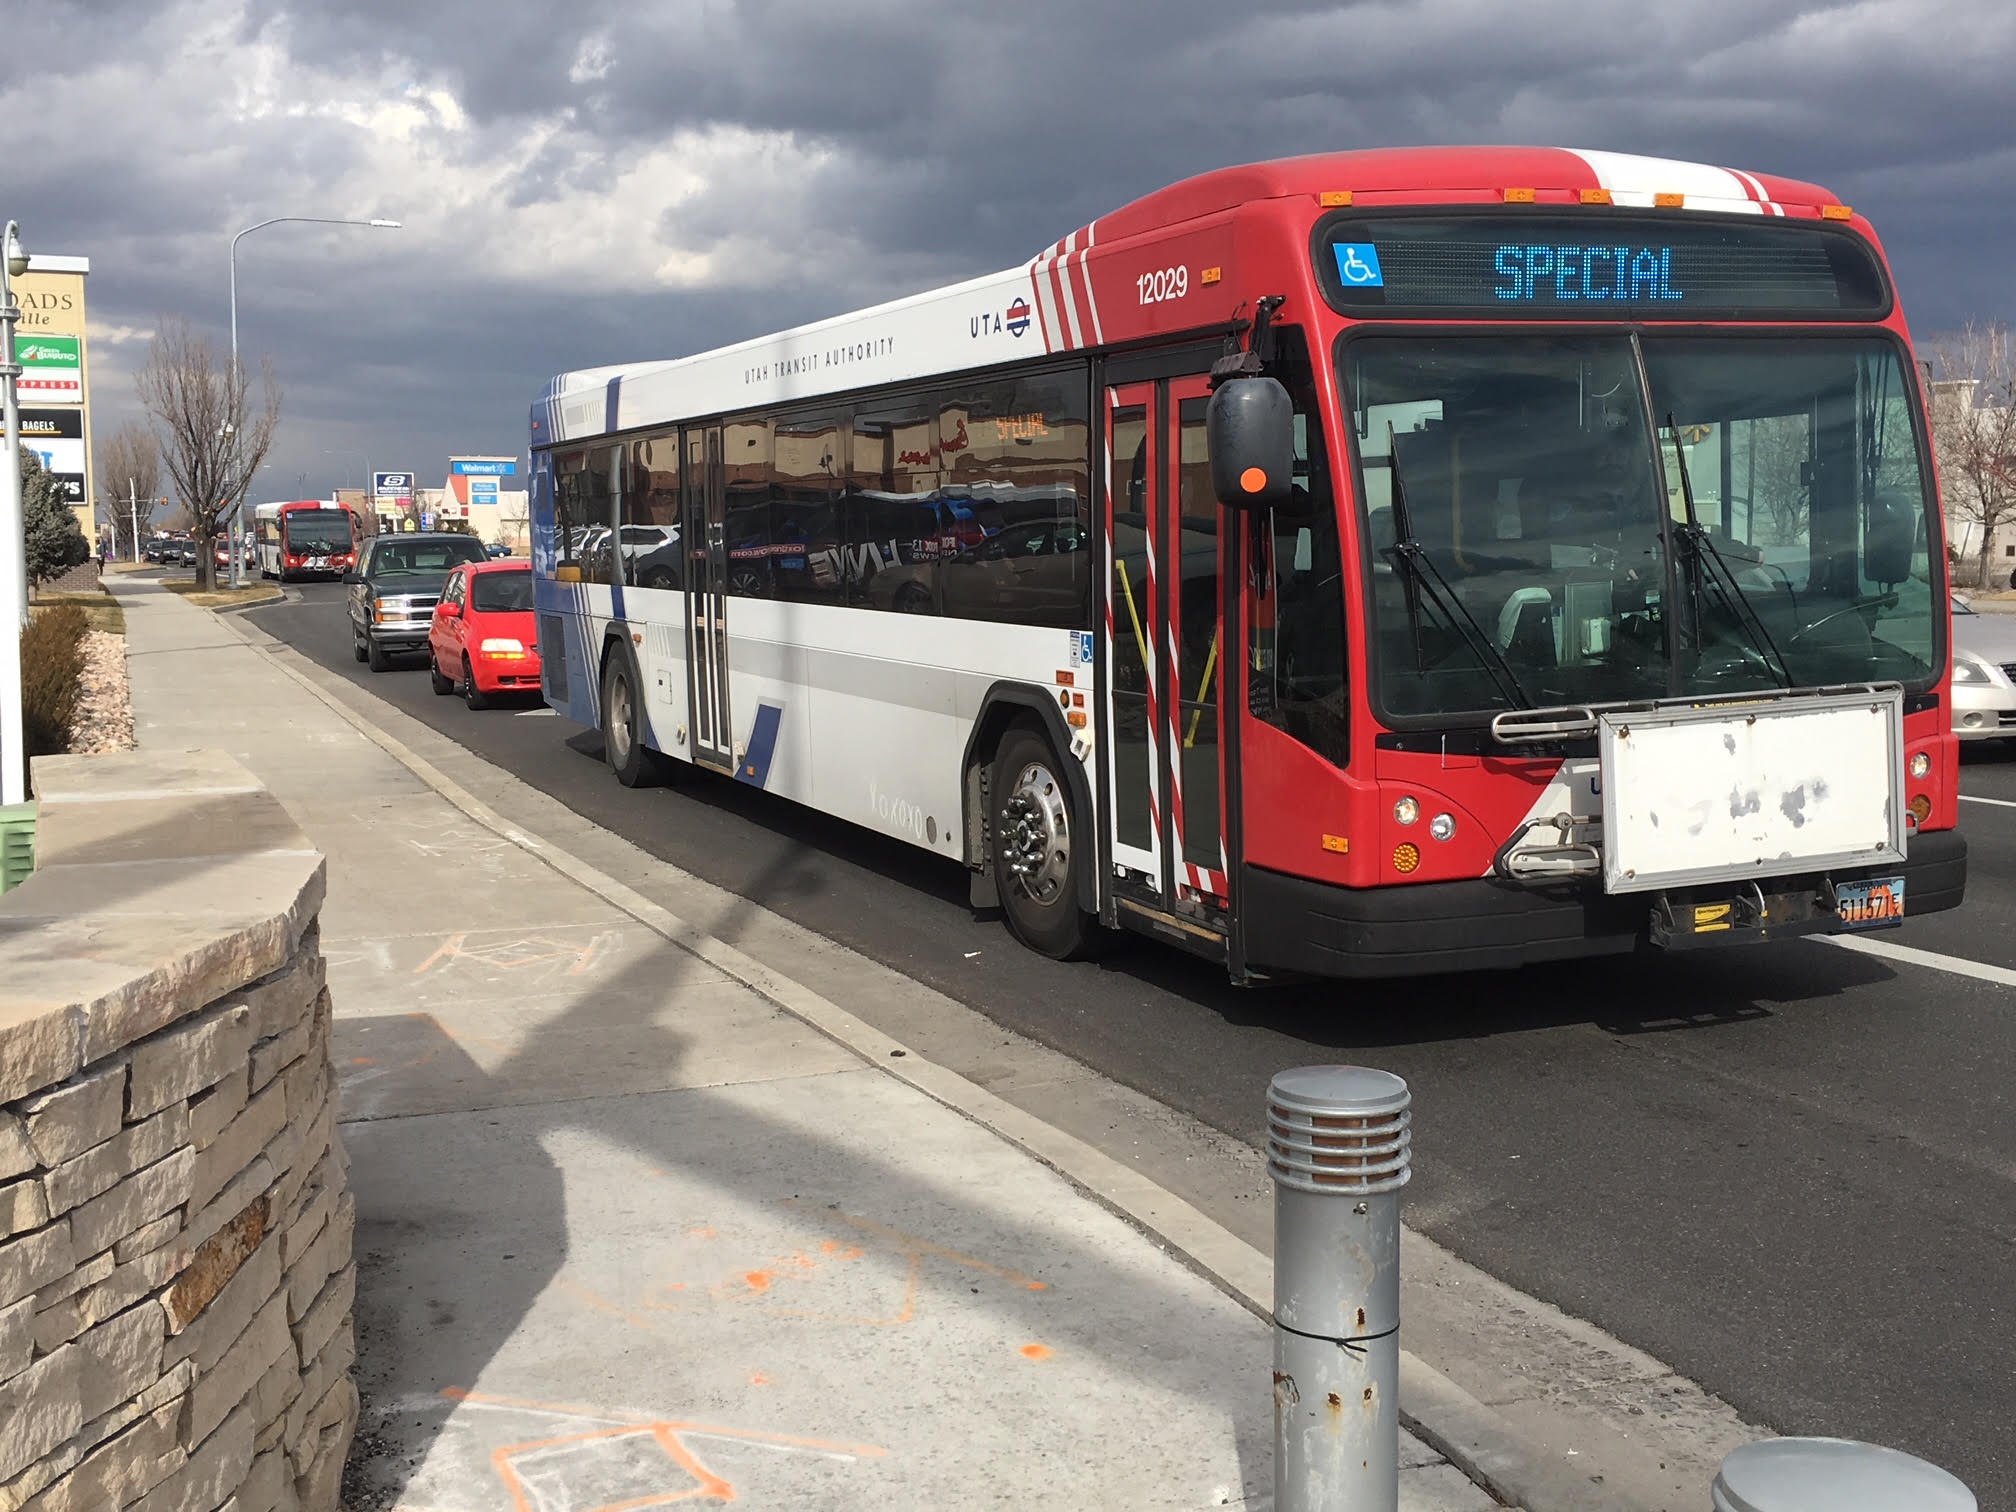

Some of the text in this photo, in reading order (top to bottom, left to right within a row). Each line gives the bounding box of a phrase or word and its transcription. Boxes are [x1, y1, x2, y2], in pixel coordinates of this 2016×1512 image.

[1136, 264, 1188, 305] 12029
[1494, 246, 1683, 299] SPECIAL
[970, 311, 1002, 338] UTA
[744, 336, 894, 384] UTAH TRANSIT AUTHORITY
[17, 380, 77, 389] XPRESS
[22, 421, 55, 431] BAGELS
[460, 463, 496, 473] Walmart
